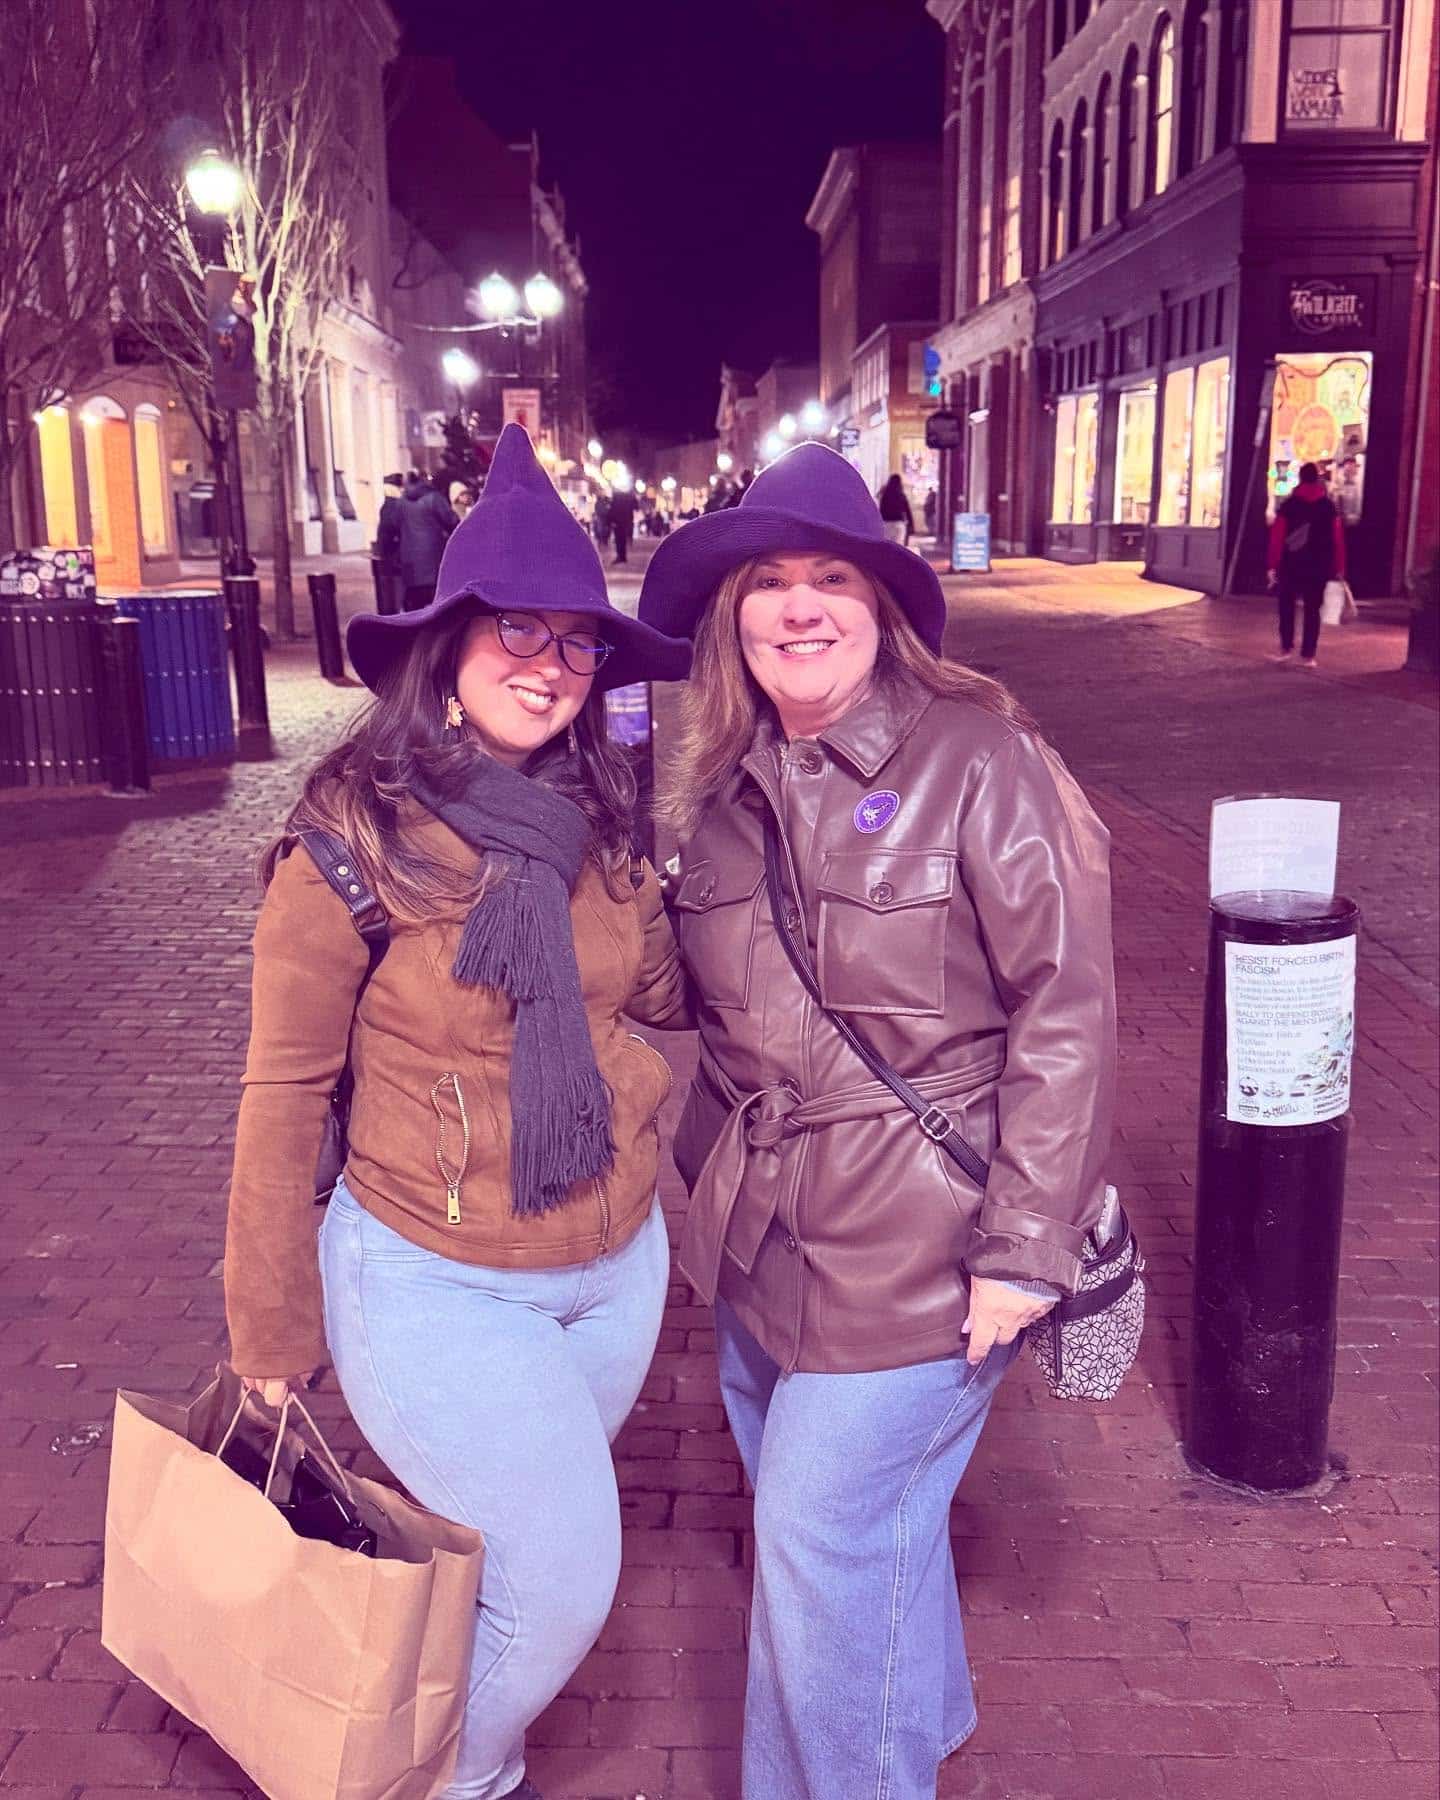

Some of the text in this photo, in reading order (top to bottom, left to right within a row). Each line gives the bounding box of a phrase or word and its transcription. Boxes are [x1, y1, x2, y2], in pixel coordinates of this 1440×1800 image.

[1233, 954, 1270, 965] RESIST
[1271, 955, 1317, 966] FORCED
[1234, 963, 1280, 975] FASCISM
